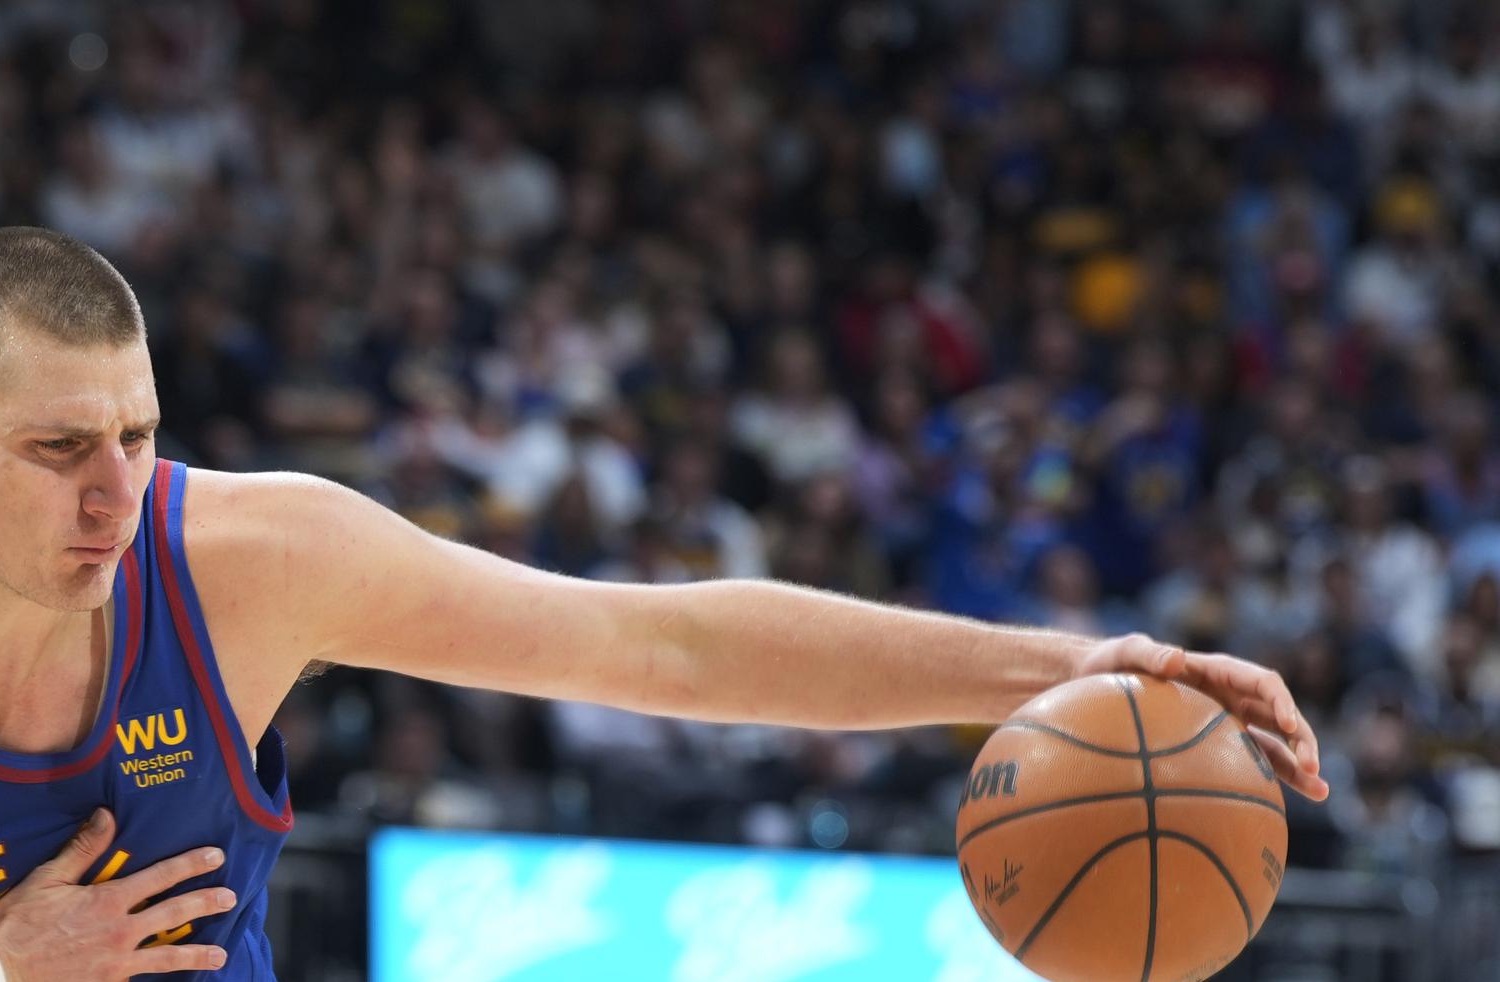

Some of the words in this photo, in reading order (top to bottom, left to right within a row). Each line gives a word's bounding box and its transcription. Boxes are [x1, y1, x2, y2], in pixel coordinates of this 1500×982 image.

[116, 708, 187, 755] WU
[120, 750, 194, 775] Western
[135, 767, 185, 788] Union
